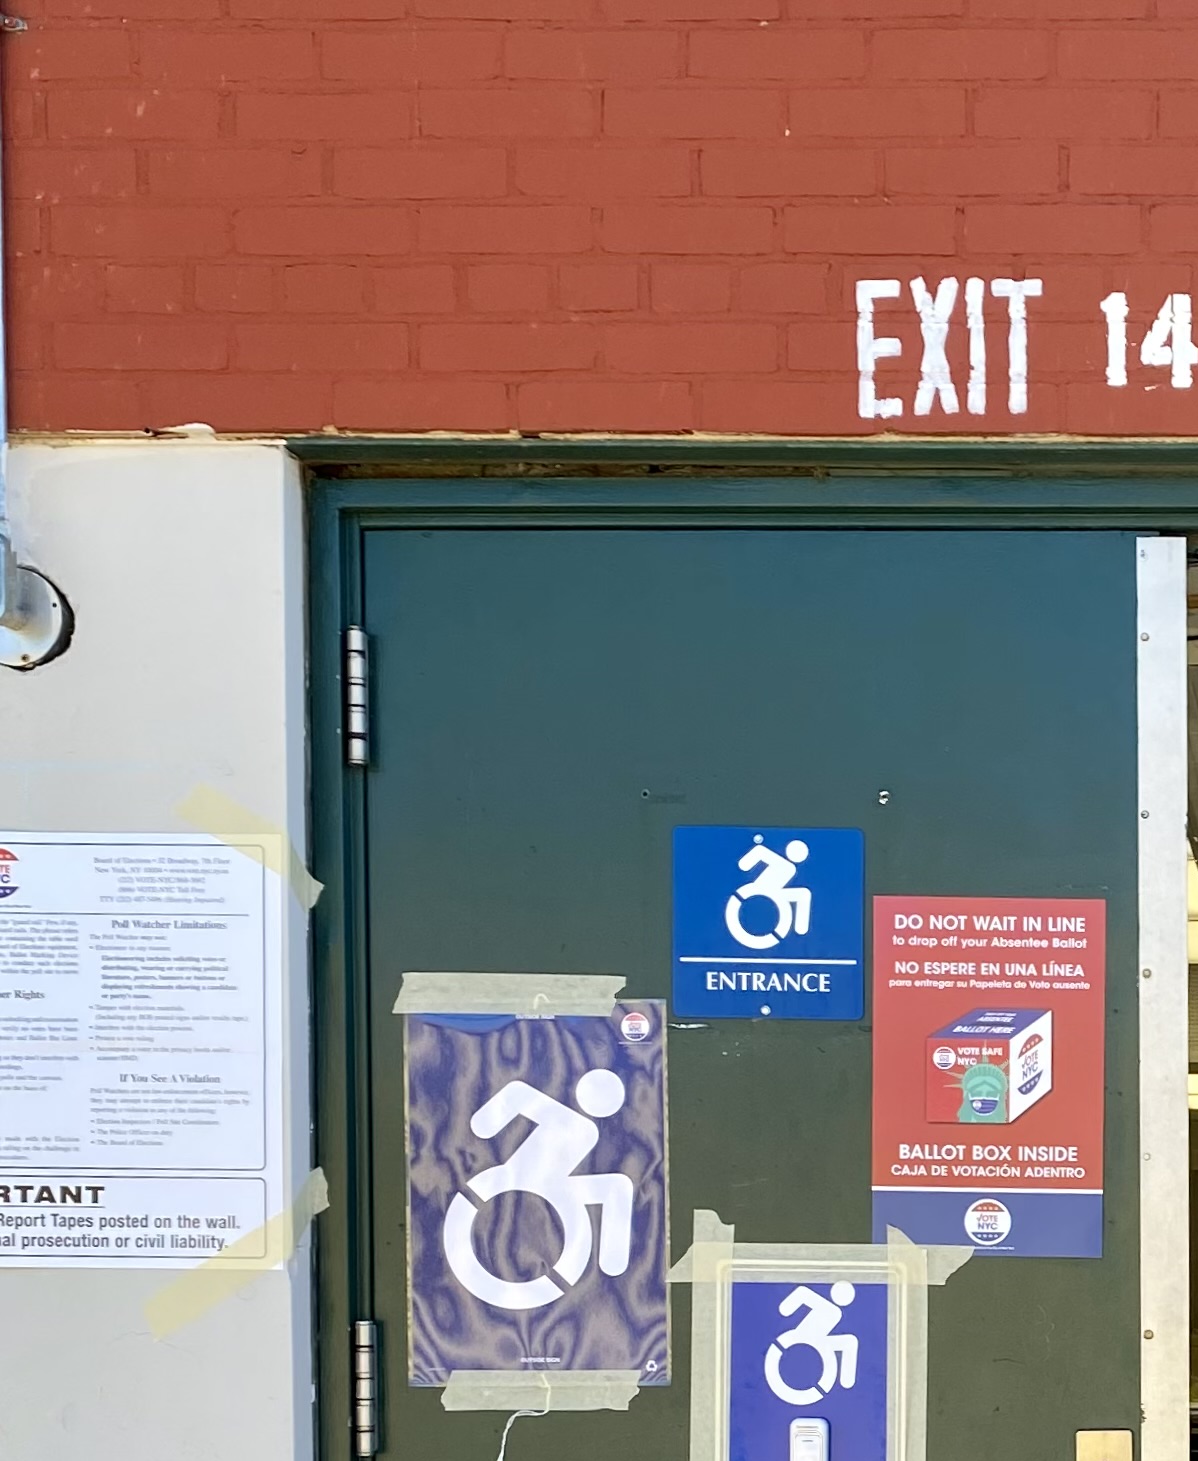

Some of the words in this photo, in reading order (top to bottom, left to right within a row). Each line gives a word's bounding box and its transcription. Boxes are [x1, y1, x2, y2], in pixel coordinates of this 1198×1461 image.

[856, 277, 1042, 418] EXIT
[1100, 292, 1198, 388] 14
[111, 919, 129, 929] Poll
[131, 919, 172, 929] Watcher
[173, 920, 228, 930] Limitations
[894, 914, 923, 930] DO
[929, 915, 967, 931] NOT
[973, 915, 1017, 932] WAIT
[1022, 916, 1042, 932] IN
[1047, 917, 1086, 933] LINE
[892, 935, 905, 946] to
[908, 935, 938, 949] drop
[941, 935, 958, 947] off
[961, 937, 988, 949] your
[990, 936, 1048, 948] Absentee
[1052, 937, 1088, 949] Ballot
[894, 961, 920, 975] NO
[923, 962, 977, 976] ESPERE
[980, 962, 1001, 976] EN
[1004, 963, 1038, 977] UNA
[1042, 960, 1085, 977] LÍNEA
[706, 971, 831, 993] ENTRANCE
[888, 979, 912, 988] para
[914, 979, 954, 990] entregar
[956, 980, 968, 989] su
[969, 979, 1012, 990] Papeleta
[1013, 980, 1027, 989] de
[1028, 980, 1051, 990] Voto
[1052, 981, 1091, 990] ausente
[14, 989, 45, 1001] Rights
[957, 1047, 981, 1056] VOTE
[981, 1047, 1003, 1056] SAFE
[956, 1057, 978, 1066] NYC
[130, 1073, 148, 1083] You
[150, 1073, 167, 1083] See
[169, 1074, 178, 1083] A
[179, 1073, 221, 1084] Violation
[899, 1143, 966, 1160] BALLOT
[972, 1145, 1012, 1161] BOX
[1018, 1146, 1078, 1162] INSIDE
[891, 1164, 927, 1176] CAJA
[931, 1165, 948, 1177] DE
[952, 1163, 1021, 1177] VOTACIÓN
[1024, 1166, 1086, 1178] ADENTRO
[50, 1213, 94, 1230] Tapes
[99, 1214, 148, 1231] posted
[154, 1217, 172, 1229] on
[177, 1214, 200, 1229] the
[205, 1215, 241, 1230] wall.
[977, 1222, 999, 1231] NYC
[0, 1232, 16, 1247] al
[21, 1233, 109, 1250] prosecution
[115, 1236, 131, 1248] or
[135, 1234, 165, 1249] civil
[170, 1235, 229, 1252] liability.
